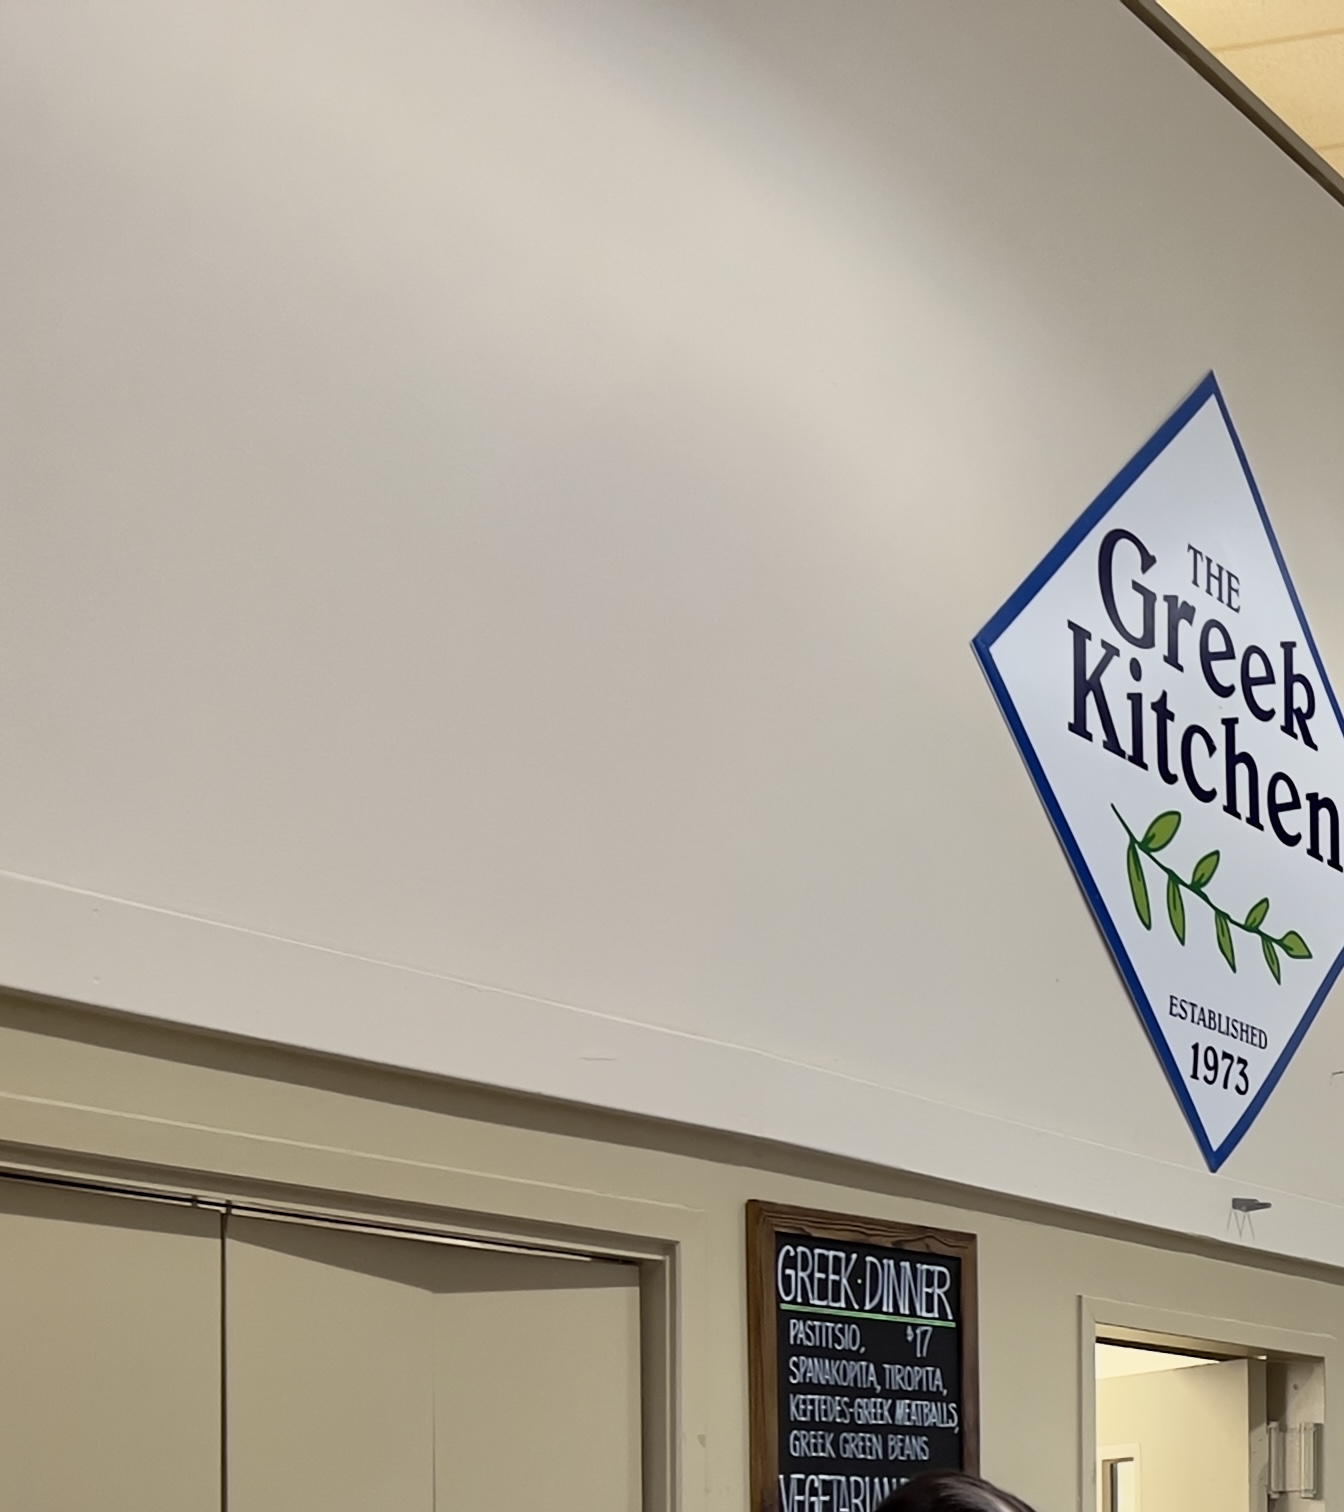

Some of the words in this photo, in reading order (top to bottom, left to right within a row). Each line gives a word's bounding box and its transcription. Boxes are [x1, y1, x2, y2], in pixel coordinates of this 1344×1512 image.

[1187, 543, 1241, 613] THE
[1097, 528, 1319, 752] Greek
[1067, 619, 1344, 873] Kitchen
[1169, 995, 1268, 1049] ESTABLISHED
[1190, 1042, 1249, 1096] 1973
[789, 1319, 866, 1354] PASTITSIO,
[906, 1325, 933, 1358] $17
[788, 1356, 881, 1393] SPANAKOPITA,
[882, 1363, 948, 1396] TIROPITA,
[895, 1399, 960, 1434] MEATBALLS,
[789, 1429, 836, 1458] GREEK
[839, 1432, 883, 1460] GREEN
[887, 1434, 929, 1460] BEANS
